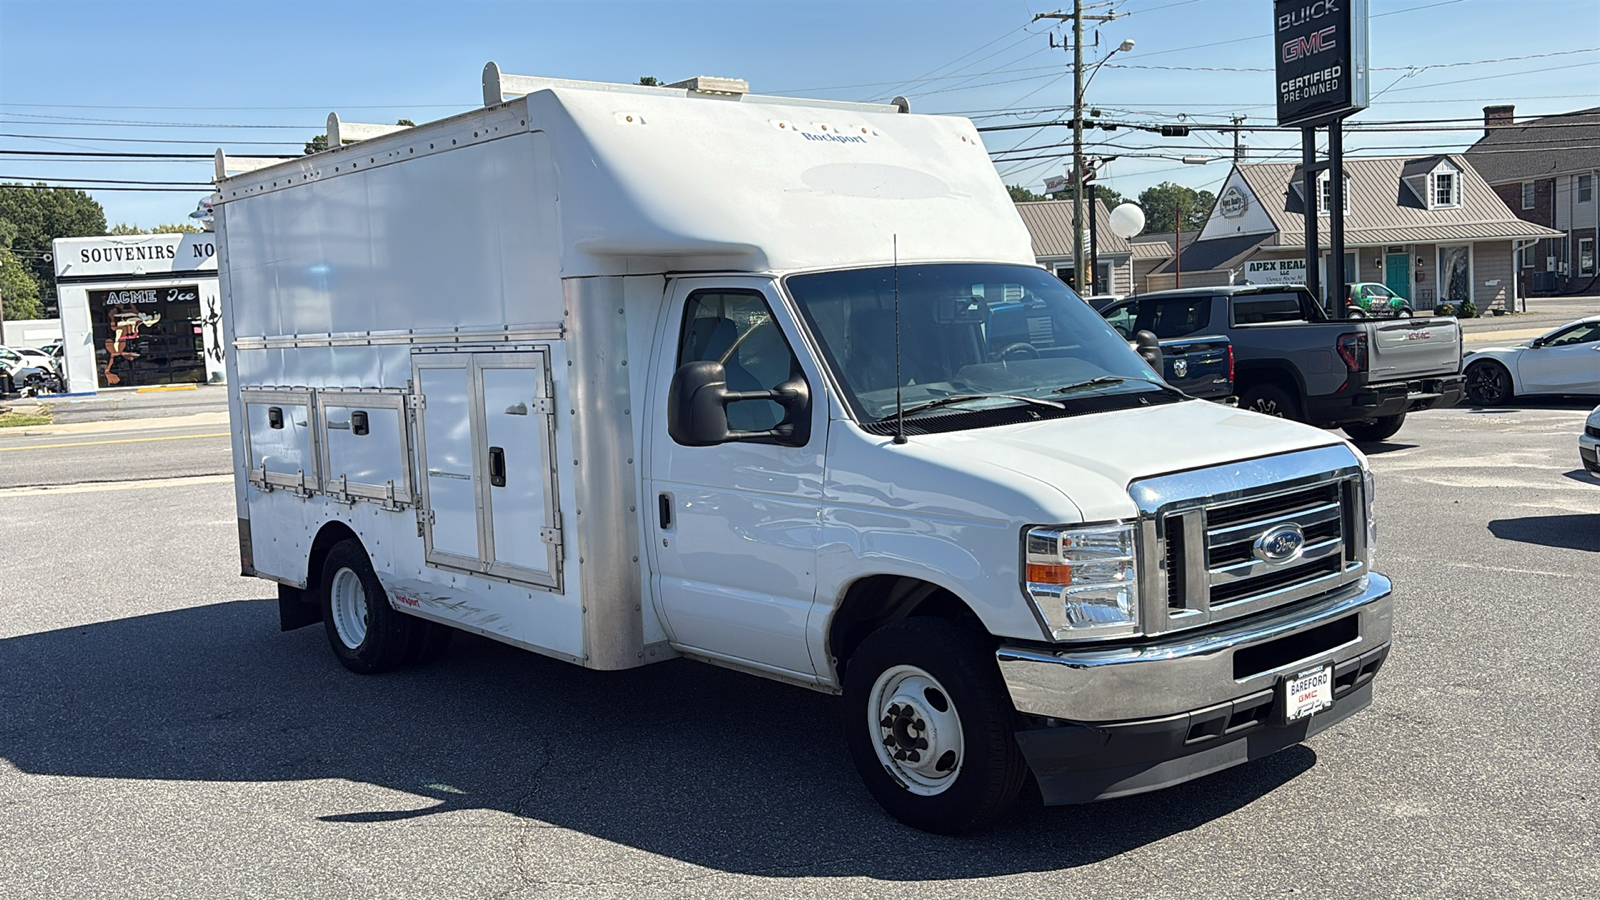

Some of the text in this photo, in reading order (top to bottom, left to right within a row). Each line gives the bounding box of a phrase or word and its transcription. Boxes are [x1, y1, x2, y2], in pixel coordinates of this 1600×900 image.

[1278, 0, 1340, 31] BUICK
[1282, 25, 1336, 63] GMC
[1280, 65, 1342, 94] CERTIFIED
[1283, 79, 1339, 104] PRE-OWNED
[801, 132, 868, 144] Rockport
[81, 244, 175, 263] SOUVENIRS
[1249, 260, 1306, 272] APEX REAL
[106, 288, 196, 305] ACME Ice
[1408, 332, 1430, 341] GMC
[1275, 536, 1297, 553] Ford
[1290, 674, 1328, 696] BAREFORD
[1298, 690, 1318, 703] GMC
